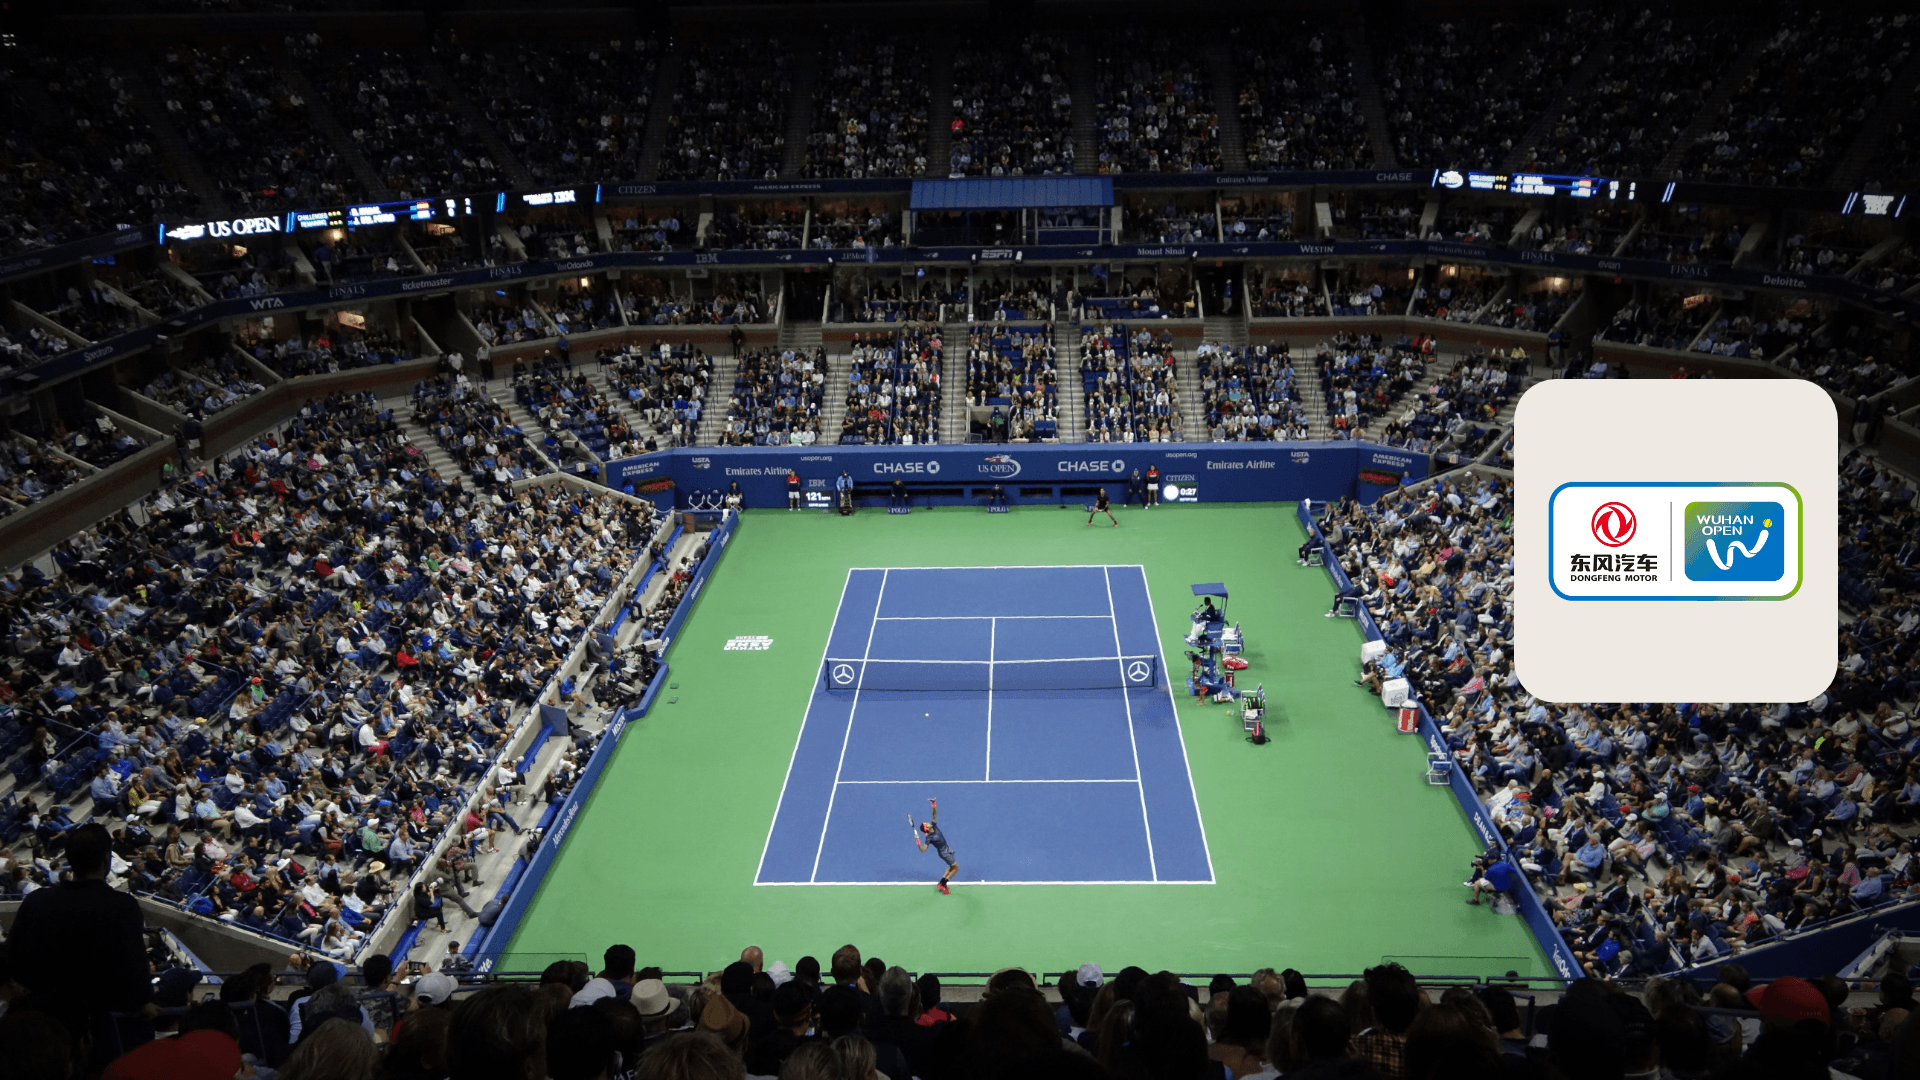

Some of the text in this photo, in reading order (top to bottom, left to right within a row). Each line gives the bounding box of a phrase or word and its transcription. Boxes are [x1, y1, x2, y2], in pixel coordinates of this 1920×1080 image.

[1376, 172, 1412, 182] CHASE
[618, 185, 656, 194] CITIZEN
[208, 216, 281, 238] US OPEN
[981, 249, 1013, 259] ESPN
[1137, 246, 1186, 255] Mount Sinai
[695, 253, 718, 264] IBM
[1521, 251, 1555, 263] FINALS
[1598, 259, 1621, 270] evian
[489, 266, 522, 278] FINALS
[1670, 264, 1709, 277] FINALS
[402, 278, 452, 291] ticketmaster
[329, 285, 365, 298] FINALS
[250, 297, 284, 310] WTA
[1372, 452, 1412, 464] AMERICAN
[1372, 458, 1406, 467] EXPRESS
[622, 461, 660, 472] AMERICAN
[873, 462, 924, 473] CHASE
[978, 464, 1015, 473] US OPEN
[1057, 461, 1109, 472] CHASE
[1206, 459, 1275, 469] Emirates Airline
[622, 466, 654, 477] EXPRESS
[725, 466, 792, 476] Emirates Airline
[808, 479, 826, 487] IBM
[1165, 474, 1195, 482] CITIZEN
[805, 491, 822, 501] 121
[1180, 487, 1197, 496] 0:27
